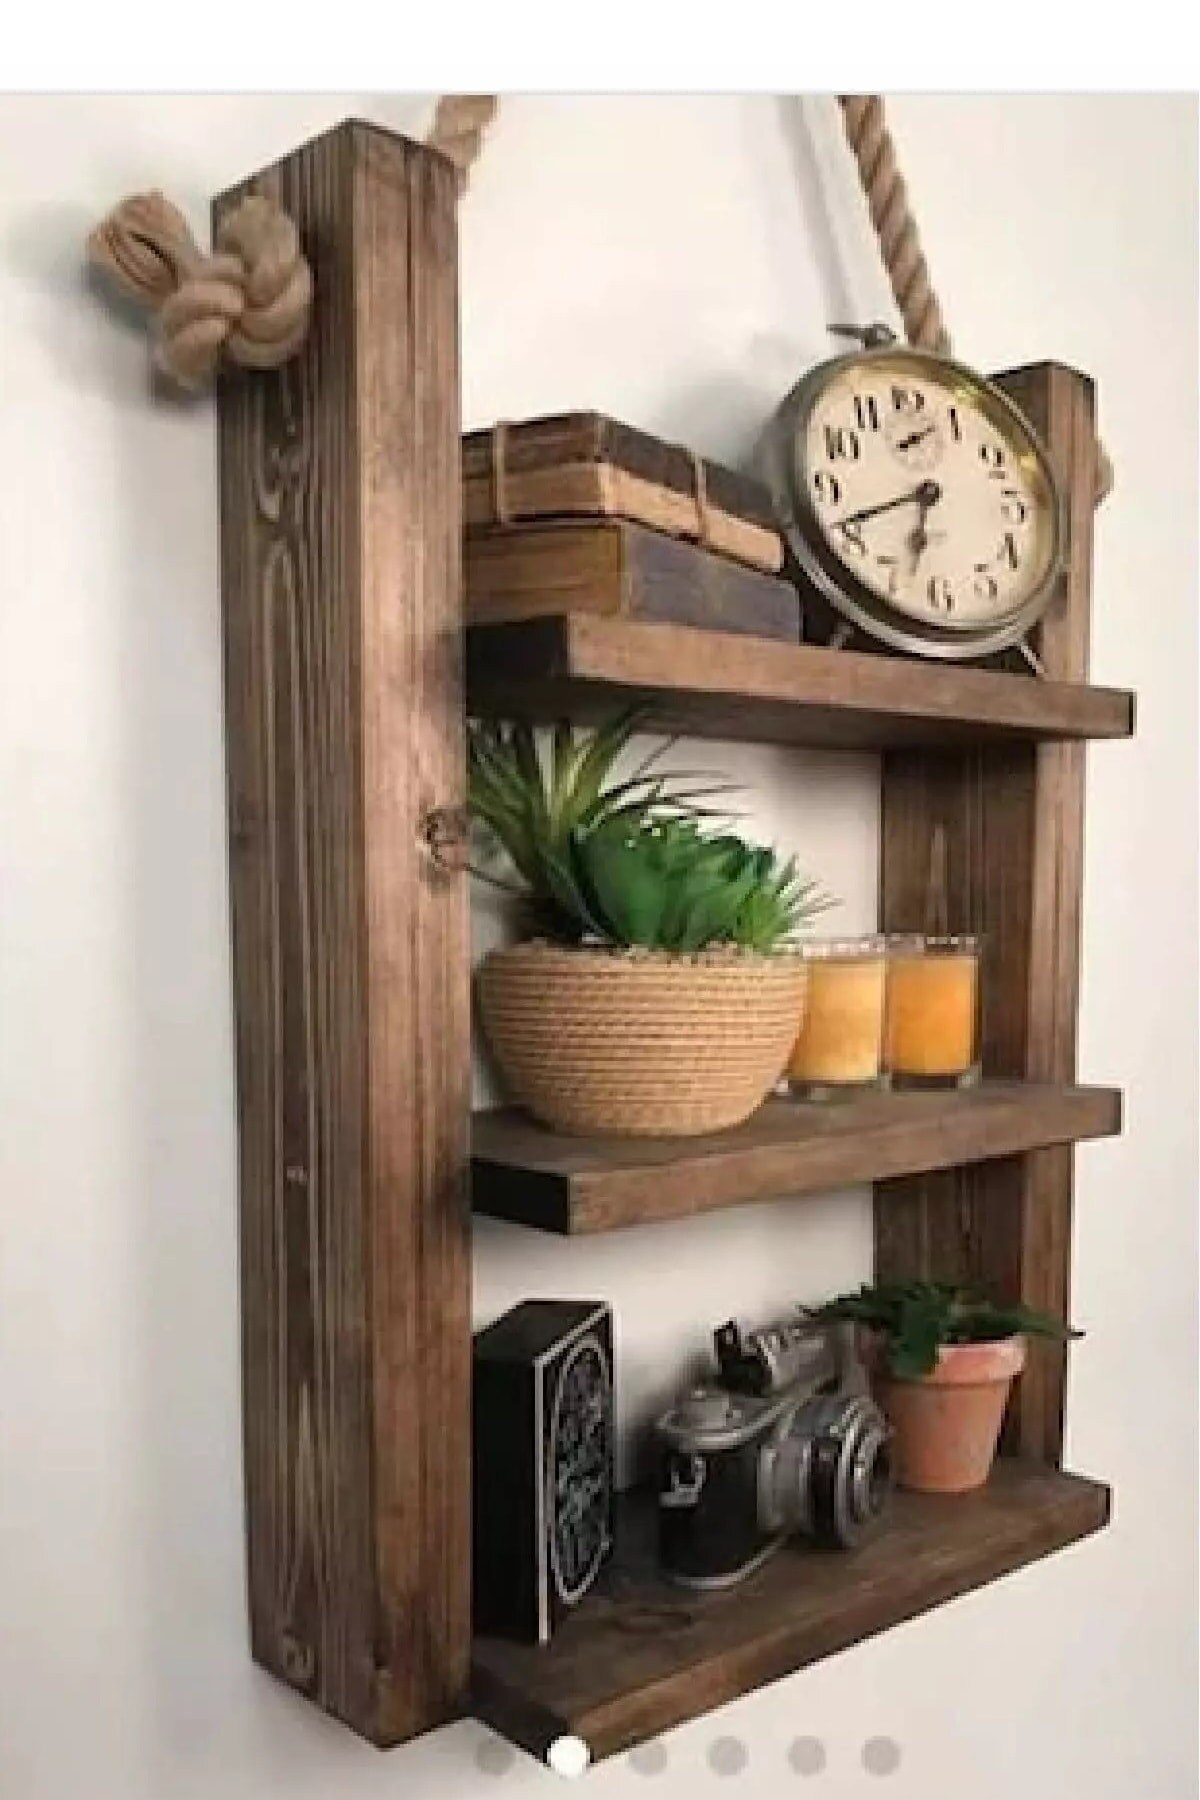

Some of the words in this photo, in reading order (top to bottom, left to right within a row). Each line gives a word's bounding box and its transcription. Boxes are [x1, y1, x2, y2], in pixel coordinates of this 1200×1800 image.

[854, 396, 878, 431] 11
[949, 406, 962, 441] 1
[814, 474, 841, 505] 9
